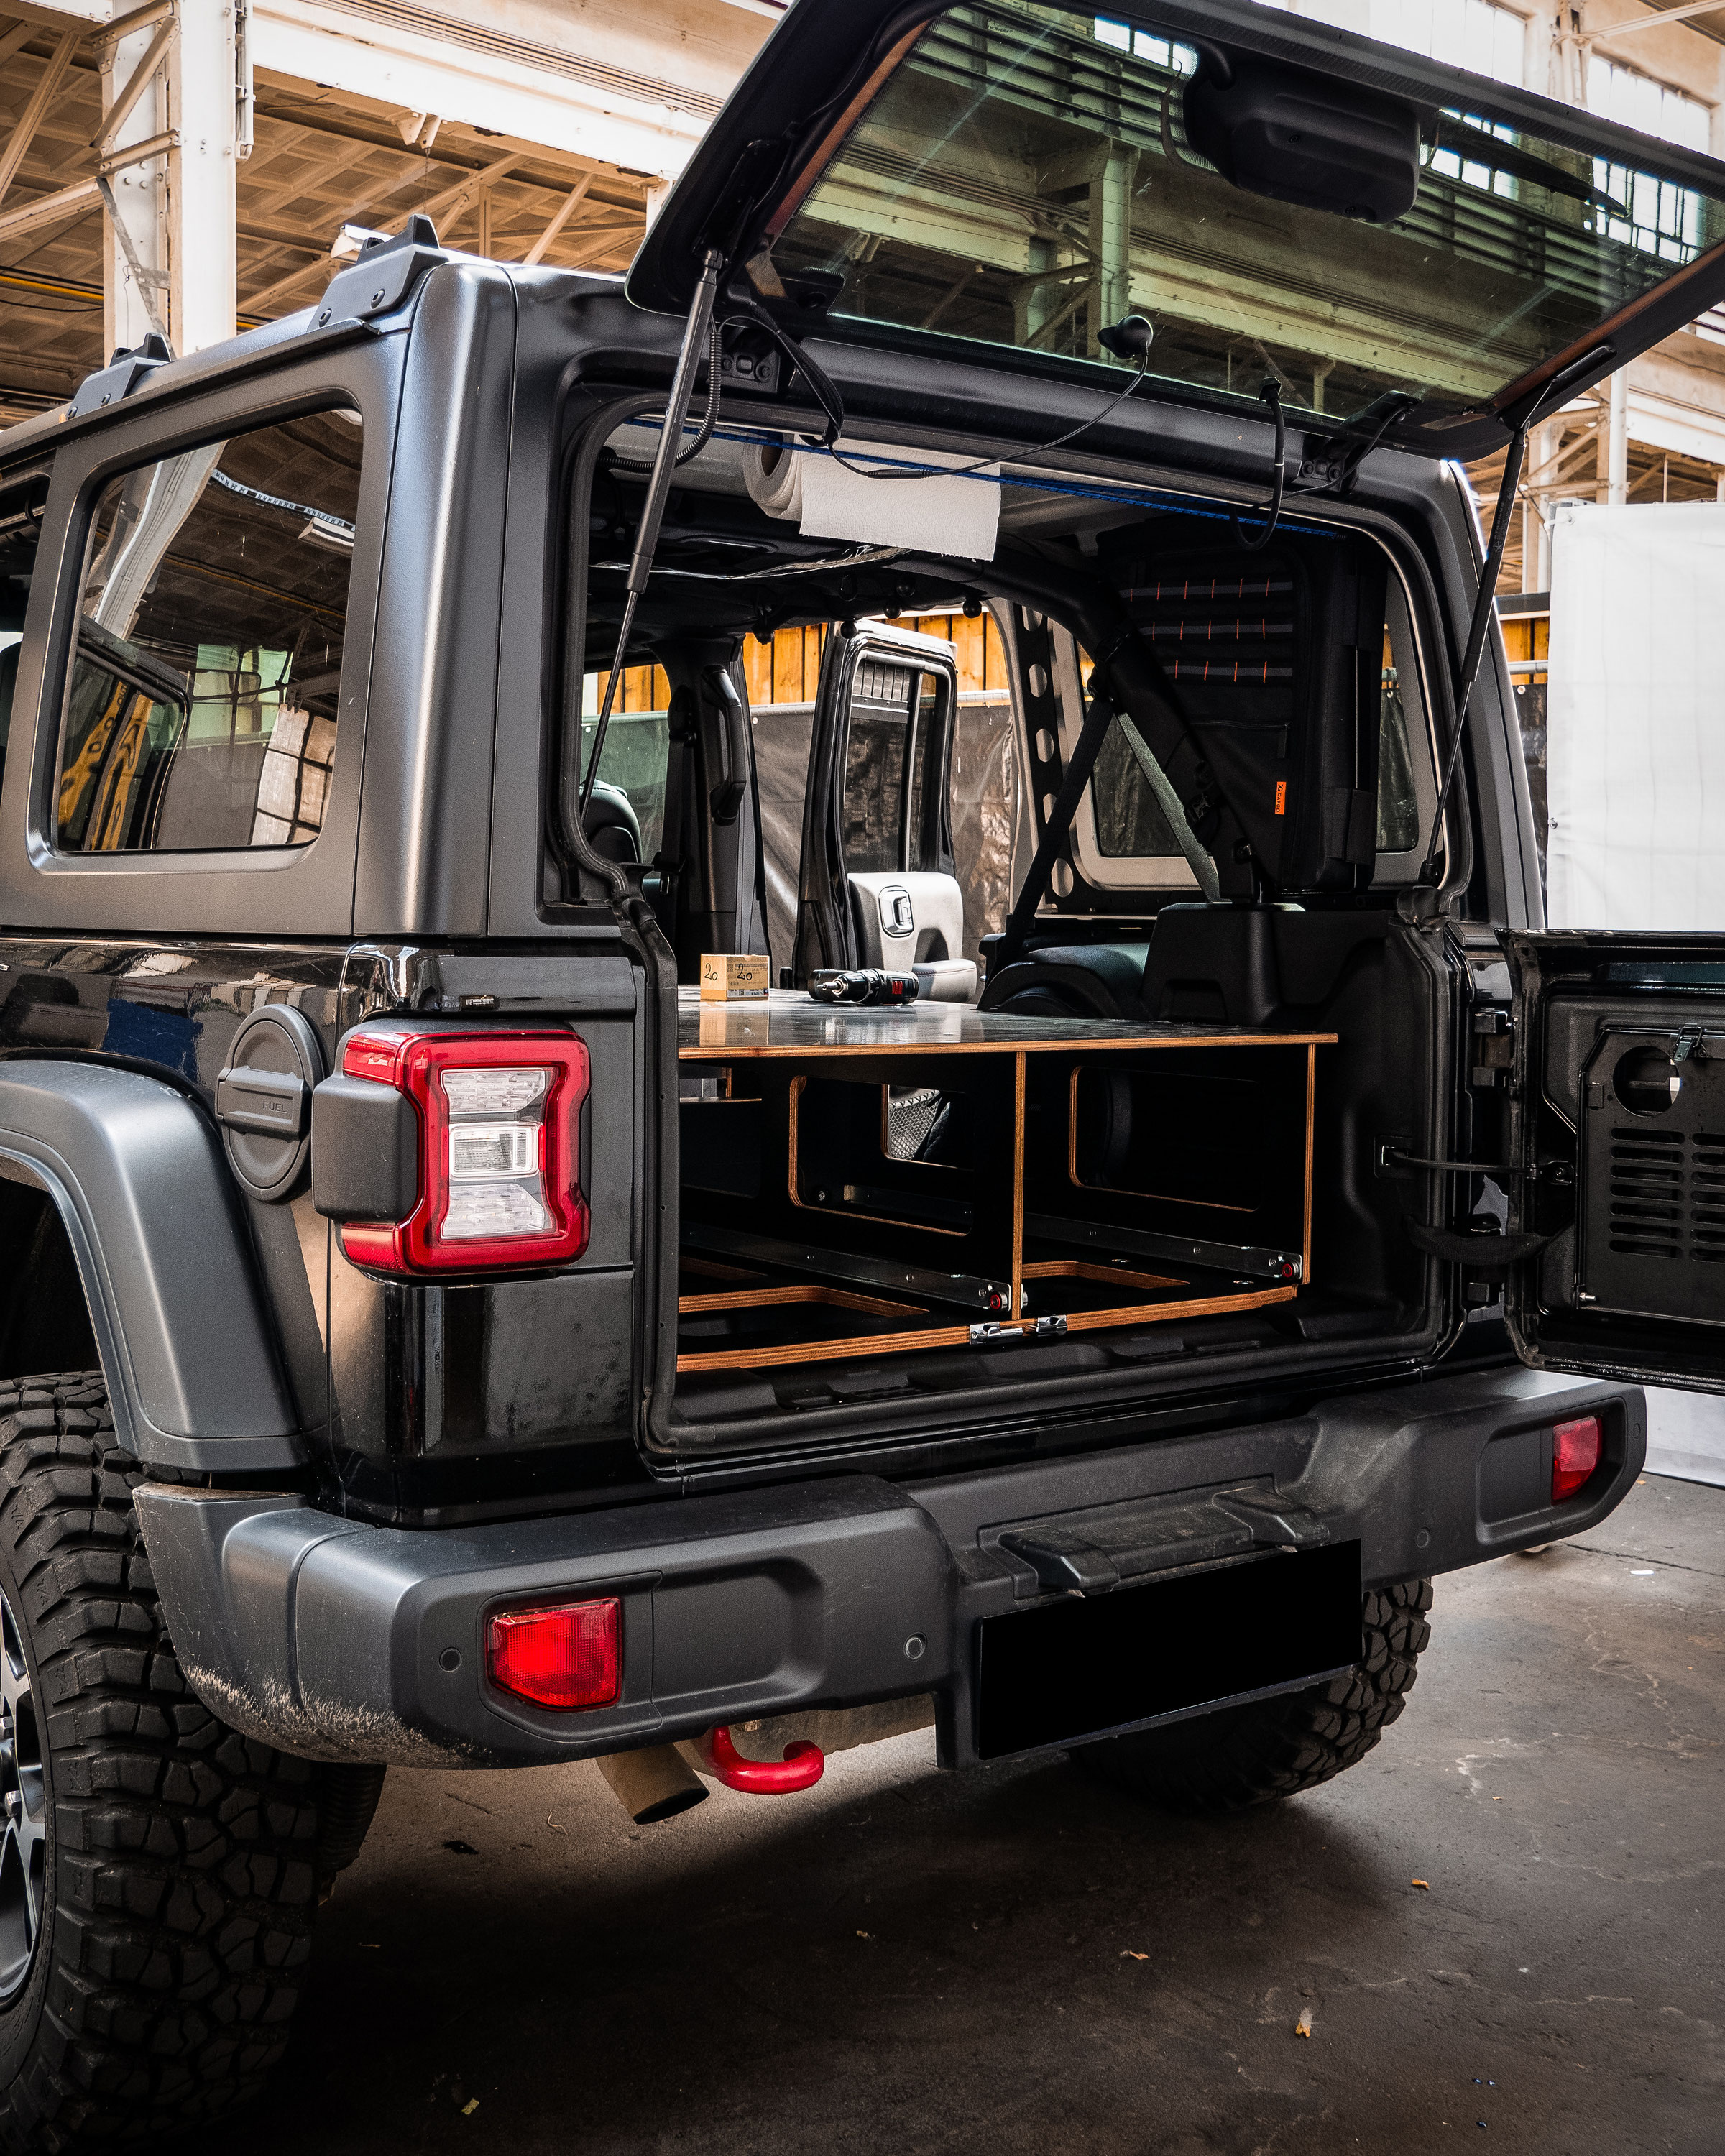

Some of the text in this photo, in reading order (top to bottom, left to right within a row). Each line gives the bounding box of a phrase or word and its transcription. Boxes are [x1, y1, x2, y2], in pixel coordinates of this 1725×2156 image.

[704, 963, 718, 980] 20
[737, 963, 753, 981] 20
[262, 1100, 288, 1114] FUEL
